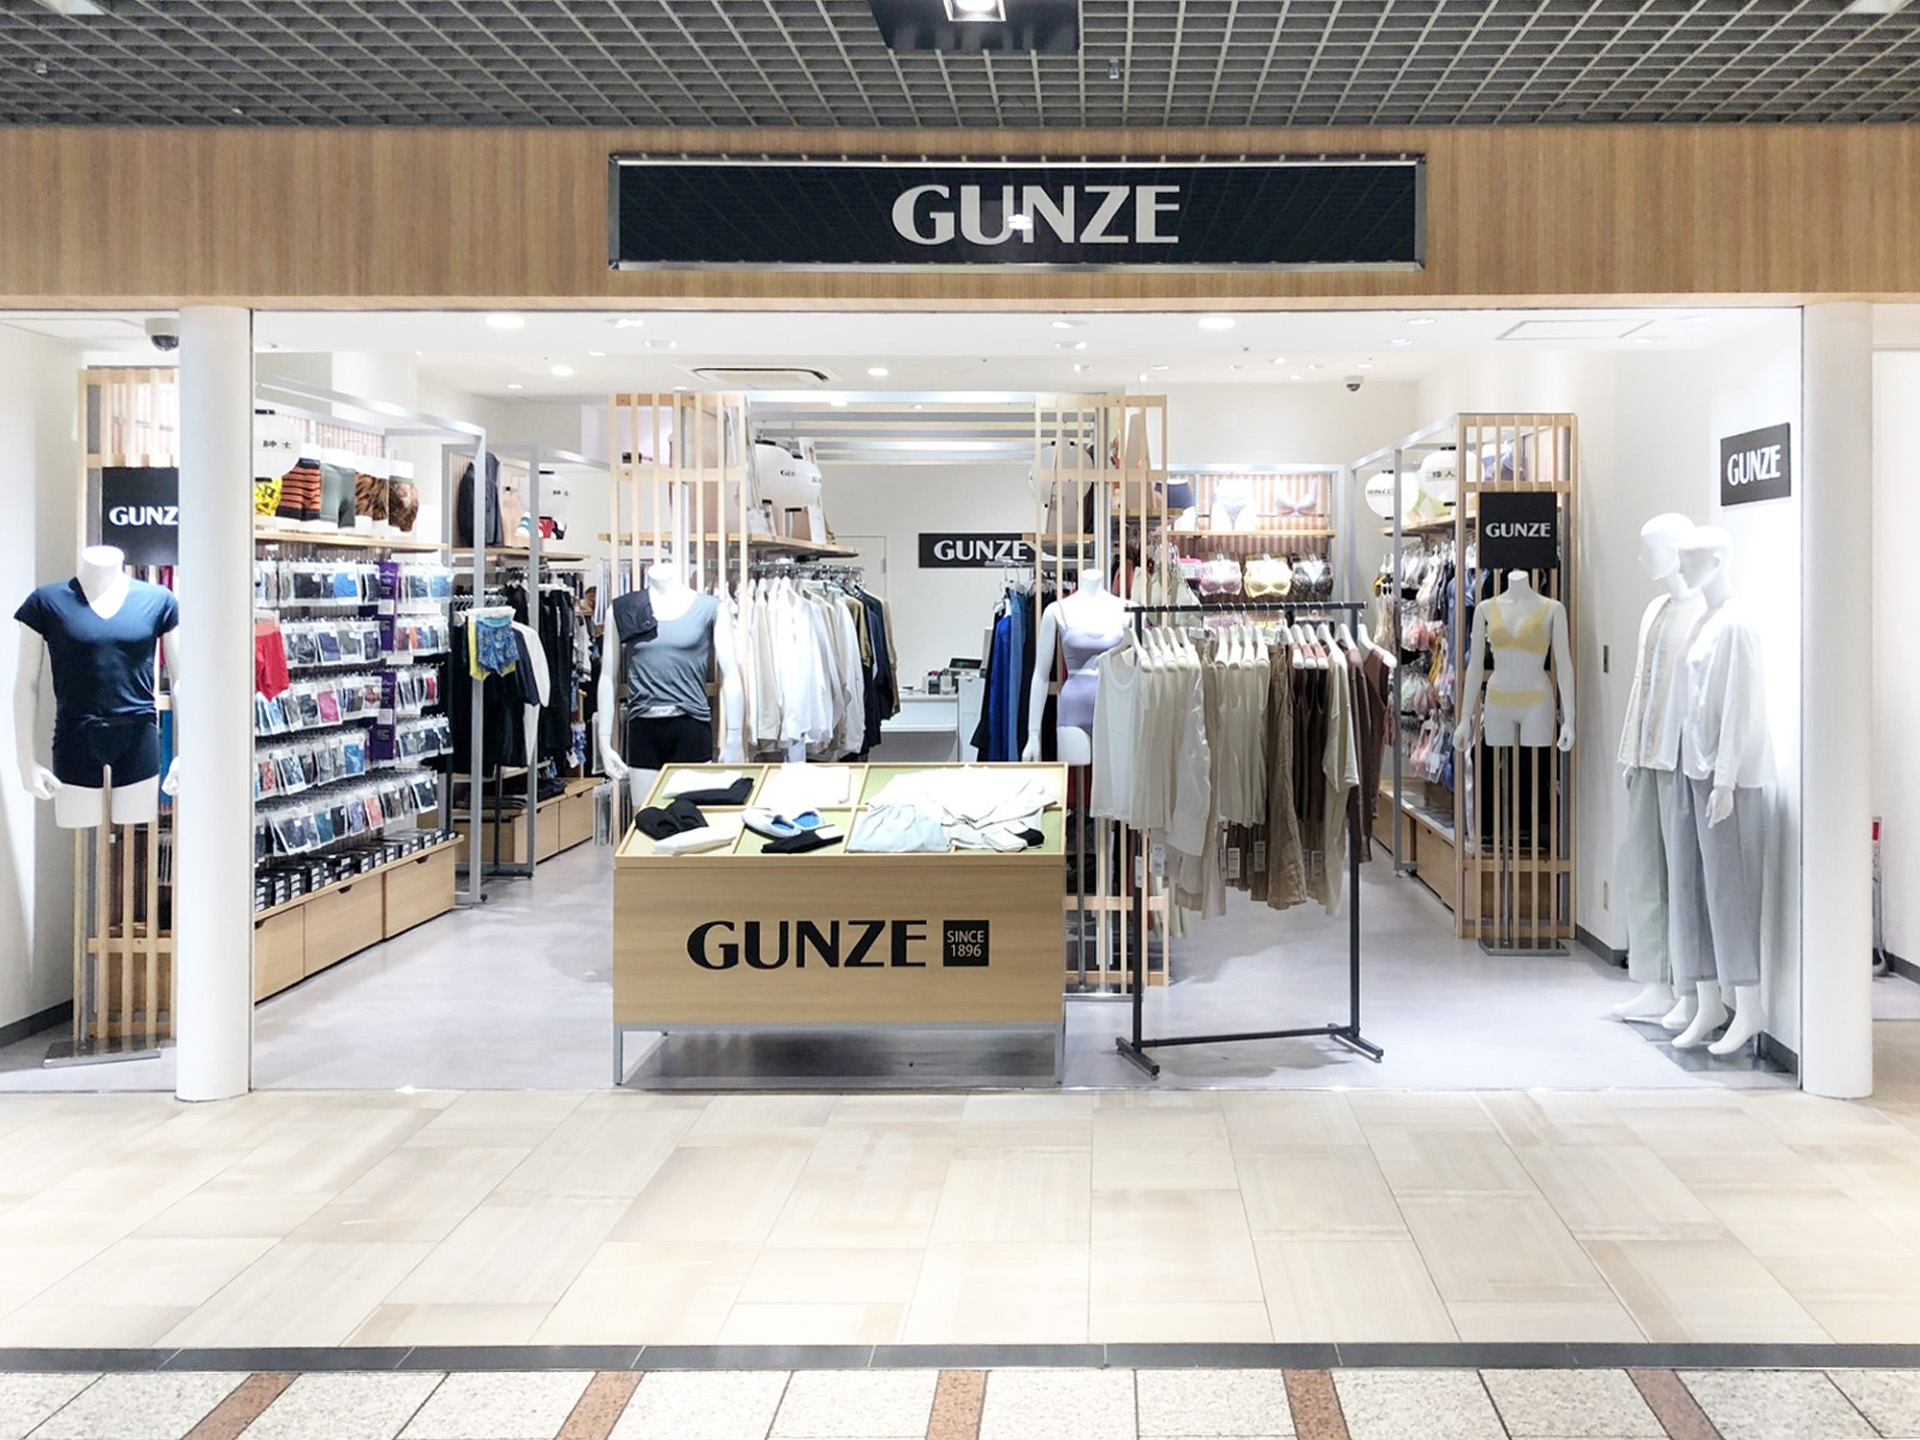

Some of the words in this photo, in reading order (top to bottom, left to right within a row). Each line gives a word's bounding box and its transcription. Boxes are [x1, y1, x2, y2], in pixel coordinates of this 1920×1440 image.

[892, 184, 1180, 245] GUNZE
[1727, 443, 1781, 486] GUNZE
[109, 505, 179, 526] GUNZ
[1485, 522, 1551, 538] GUNZE
[933, 539, 1028, 561] GUNZE
[686, 919, 928, 970] GUNZE
[947, 930, 985, 943] SINCE
[950, 944, 982, 957] 1896
